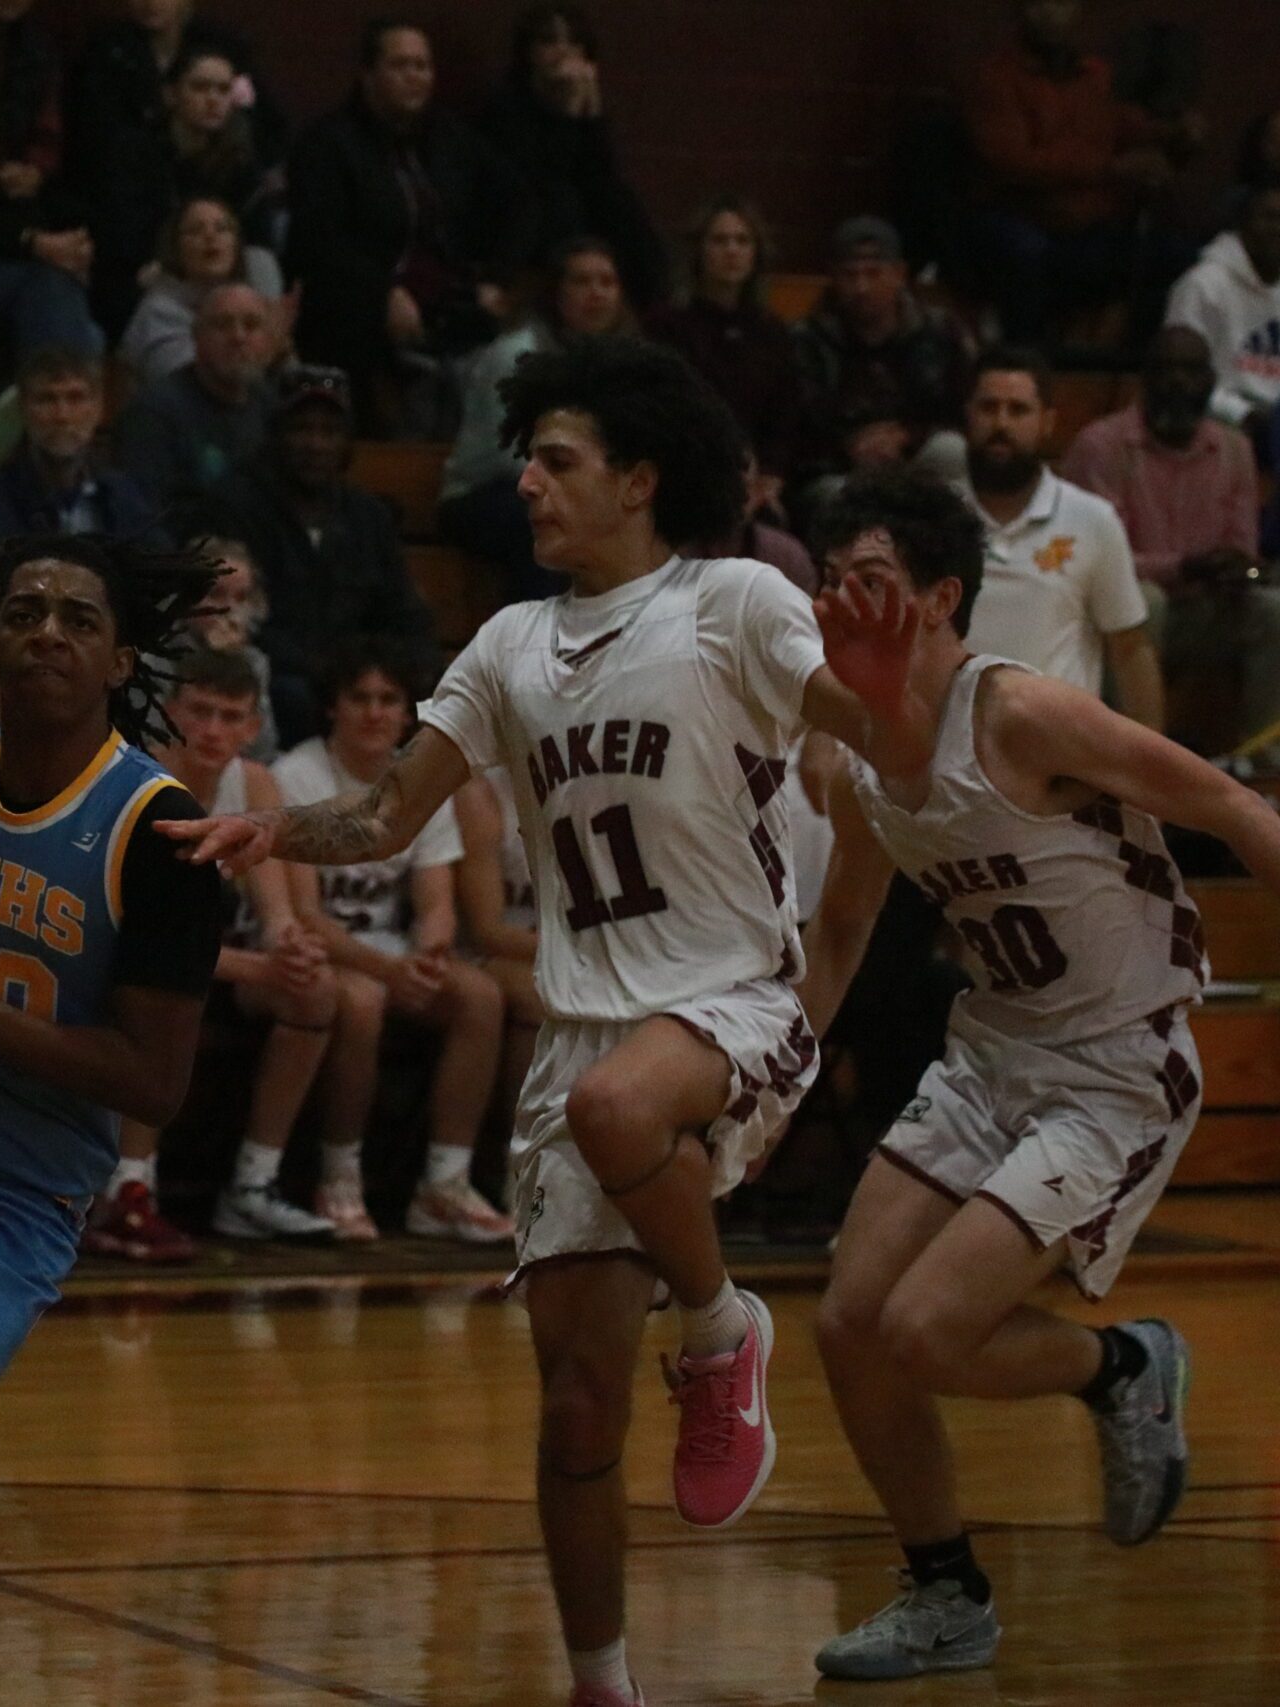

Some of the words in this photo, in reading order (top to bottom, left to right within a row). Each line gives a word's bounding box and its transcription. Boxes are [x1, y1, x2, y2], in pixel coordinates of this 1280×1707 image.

[527, 718, 671, 808] BAKER
[551, 803, 668, 932] 11
[958, 904, 1069, 990] 30
